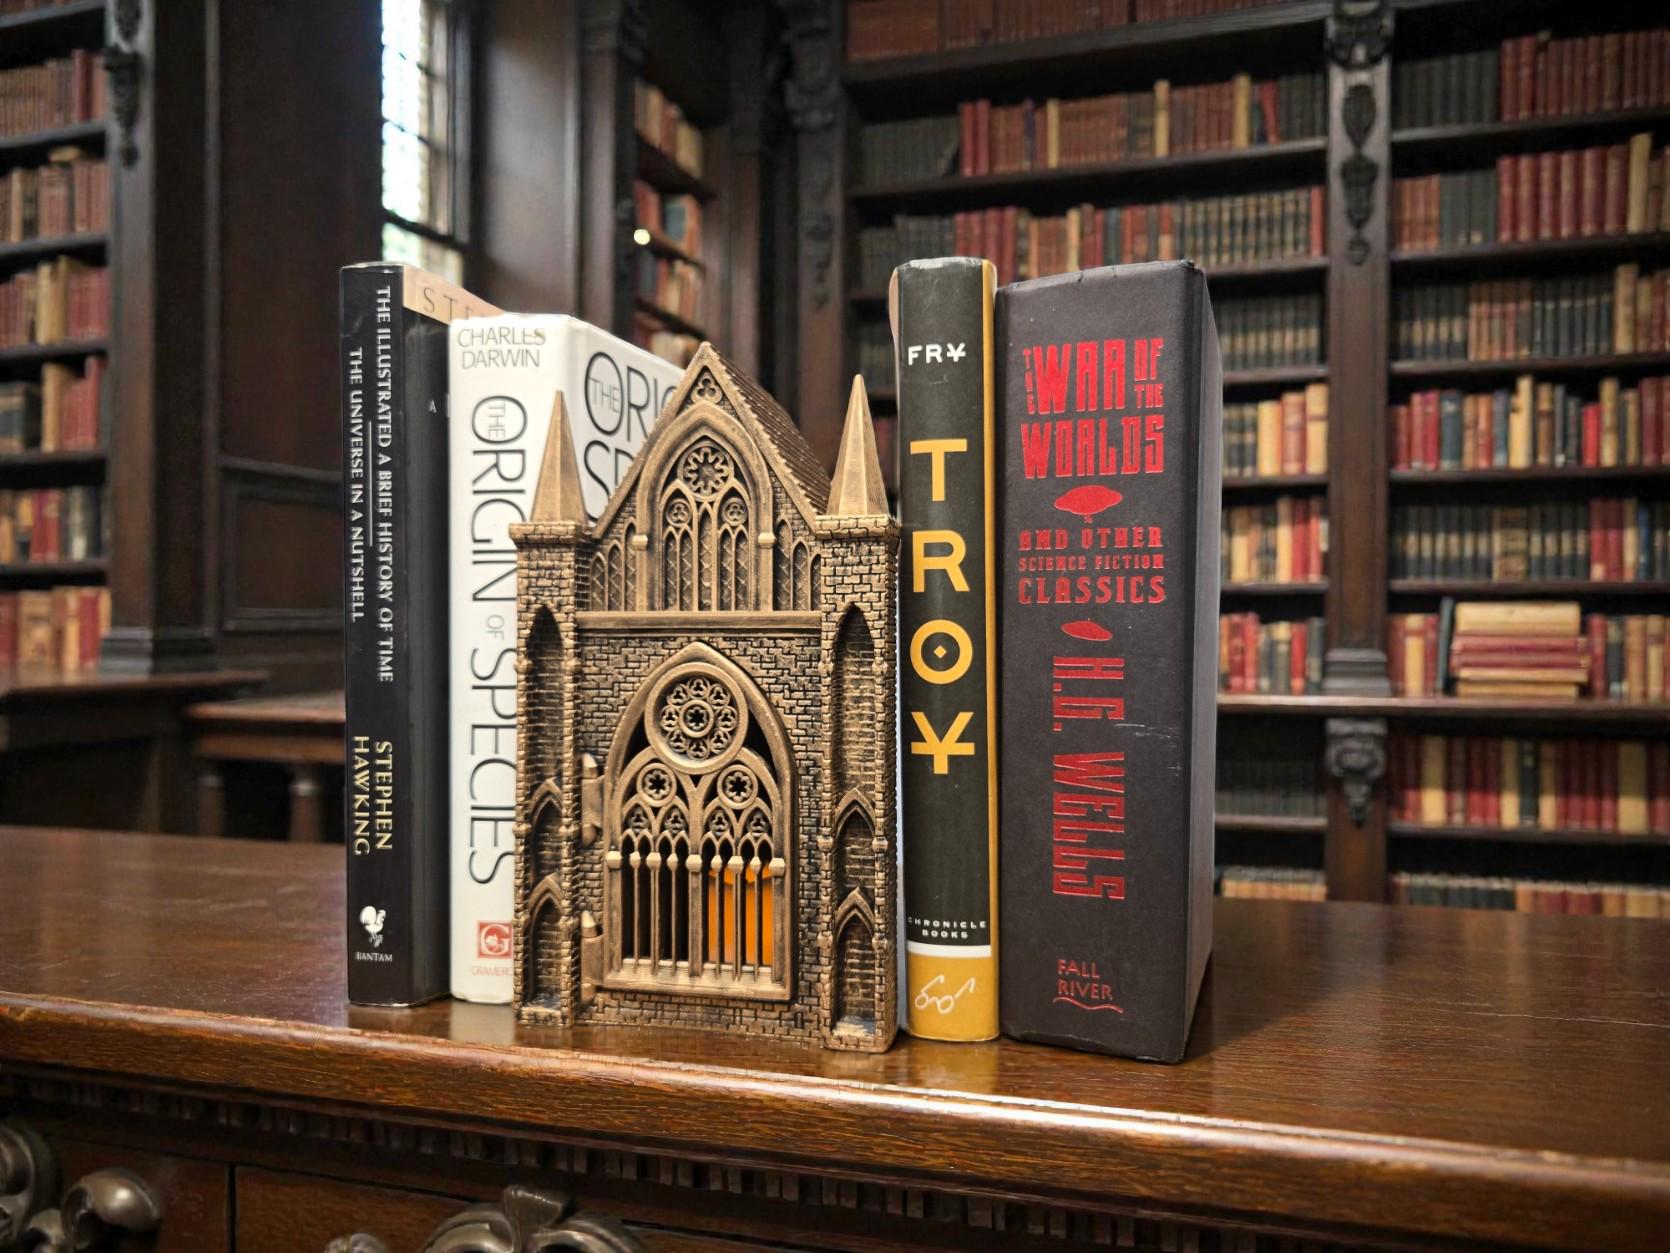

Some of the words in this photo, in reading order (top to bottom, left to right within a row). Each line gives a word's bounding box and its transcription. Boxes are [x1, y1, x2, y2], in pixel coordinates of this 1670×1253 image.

[376, 285, 391, 323] THE
[457, 326, 546, 348] CHARLES
[349, 346, 363, 385] THE
[462, 348, 541, 370] DARWIN
[1022, 348, 1035, 415] THE
[1033, 338, 1126, 415] WAR
[1134, 338, 1164, 382] OF
[376, 328, 392, 448] ILLUSTRATED
[587, 374, 620, 414] THE
[1134, 384, 1164, 409] THE
[349, 390, 364, 479] UNIVERSE
[488, 402, 506, 439] THE
[377, 452, 392, 465] A
[1020, 414, 1165, 480] WORLDS
[350, 484, 364, 504] IN
[377, 470, 393, 517] BRIEF
[471, 395, 528, 602] ORIGIN
[350, 509, 364, 522] A
[1018, 528, 1069, 551] AND
[1081, 526, 1163, 549] OTHER
[350, 526, 365, 623] NUTSHELL
[376, 522, 393, 602] HISTORY
[1018, 555, 1087, 572] SCIENCE
[1094, 554, 1165, 570] FICTION
[1018, 575, 1167, 605] CLASSICS
[377, 607, 393, 632] OF
[486, 614, 505, 641] OF
[376, 636, 393, 682] TIME
[1053, 655, 1125, 732] H.G.
[468, 647, 517, 884] SPECIES
[353, 736, 370, 856] HAWKING
[375, 741, 393, 850] STEPHEN
[1053, 751, 1126, 900] WELLS
[907, 916, 987, 929] CHRONICLE
[922, 929, 968, 939] BOOKS
[355, 951, 393, 962] BANTAM
[1057, 959, 1100, 979] FALL
[1057, 979, 1113, 1000] RIVER
